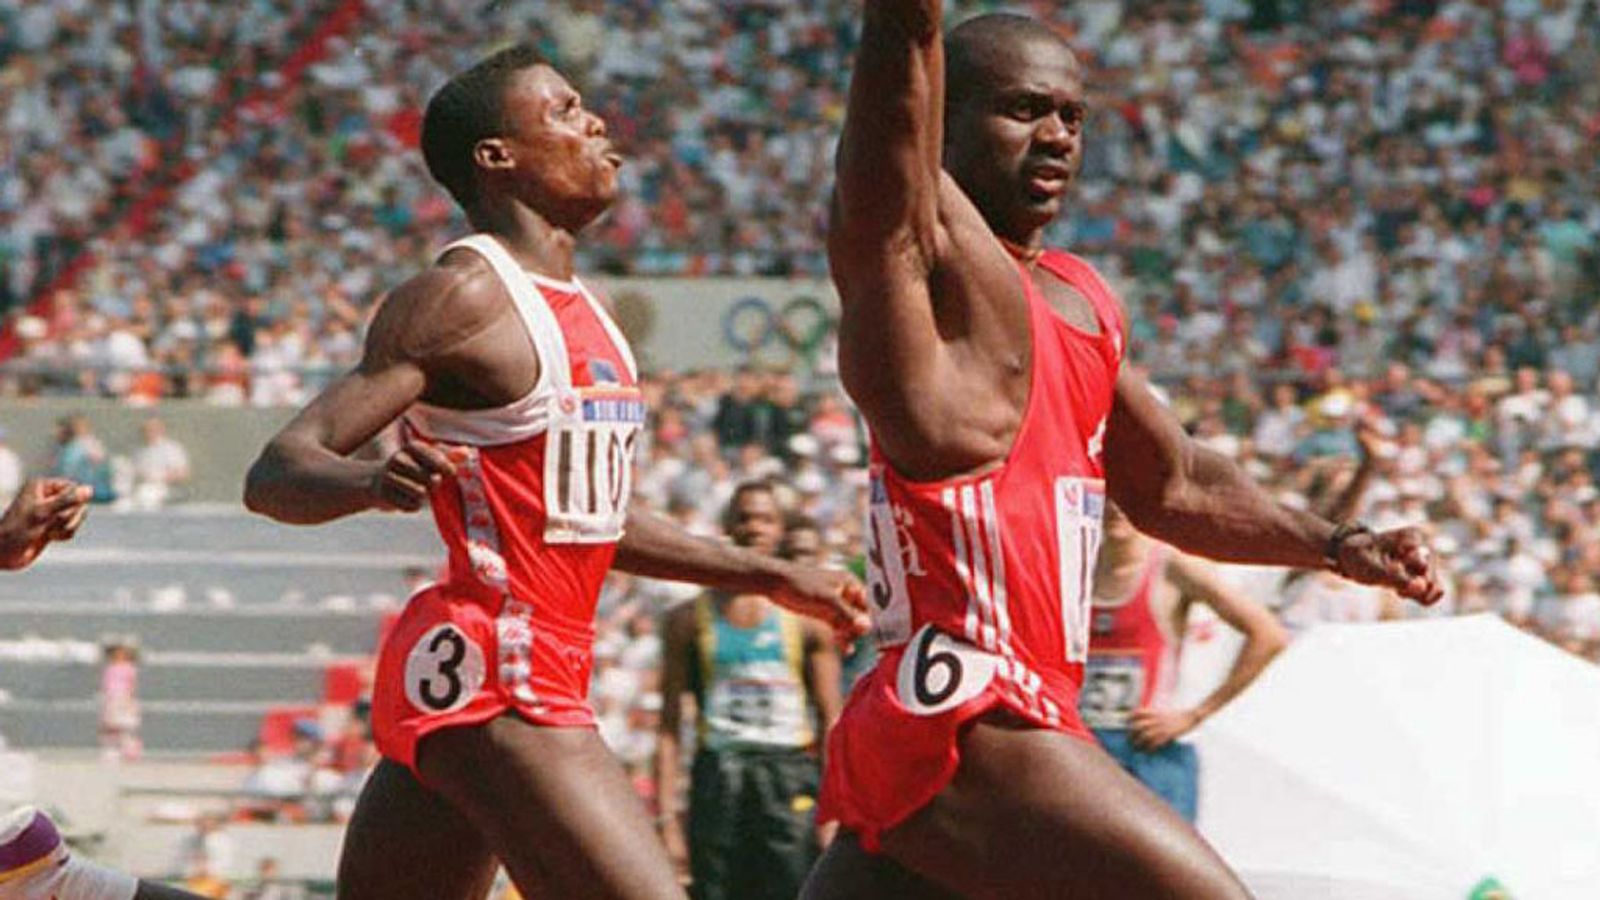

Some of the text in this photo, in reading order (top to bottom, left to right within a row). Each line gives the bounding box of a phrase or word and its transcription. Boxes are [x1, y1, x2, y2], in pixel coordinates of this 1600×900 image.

[557, 425, 638, 514] 110
[419, 626, 466, 711] 3
[914, 623, 964, 708] 6
